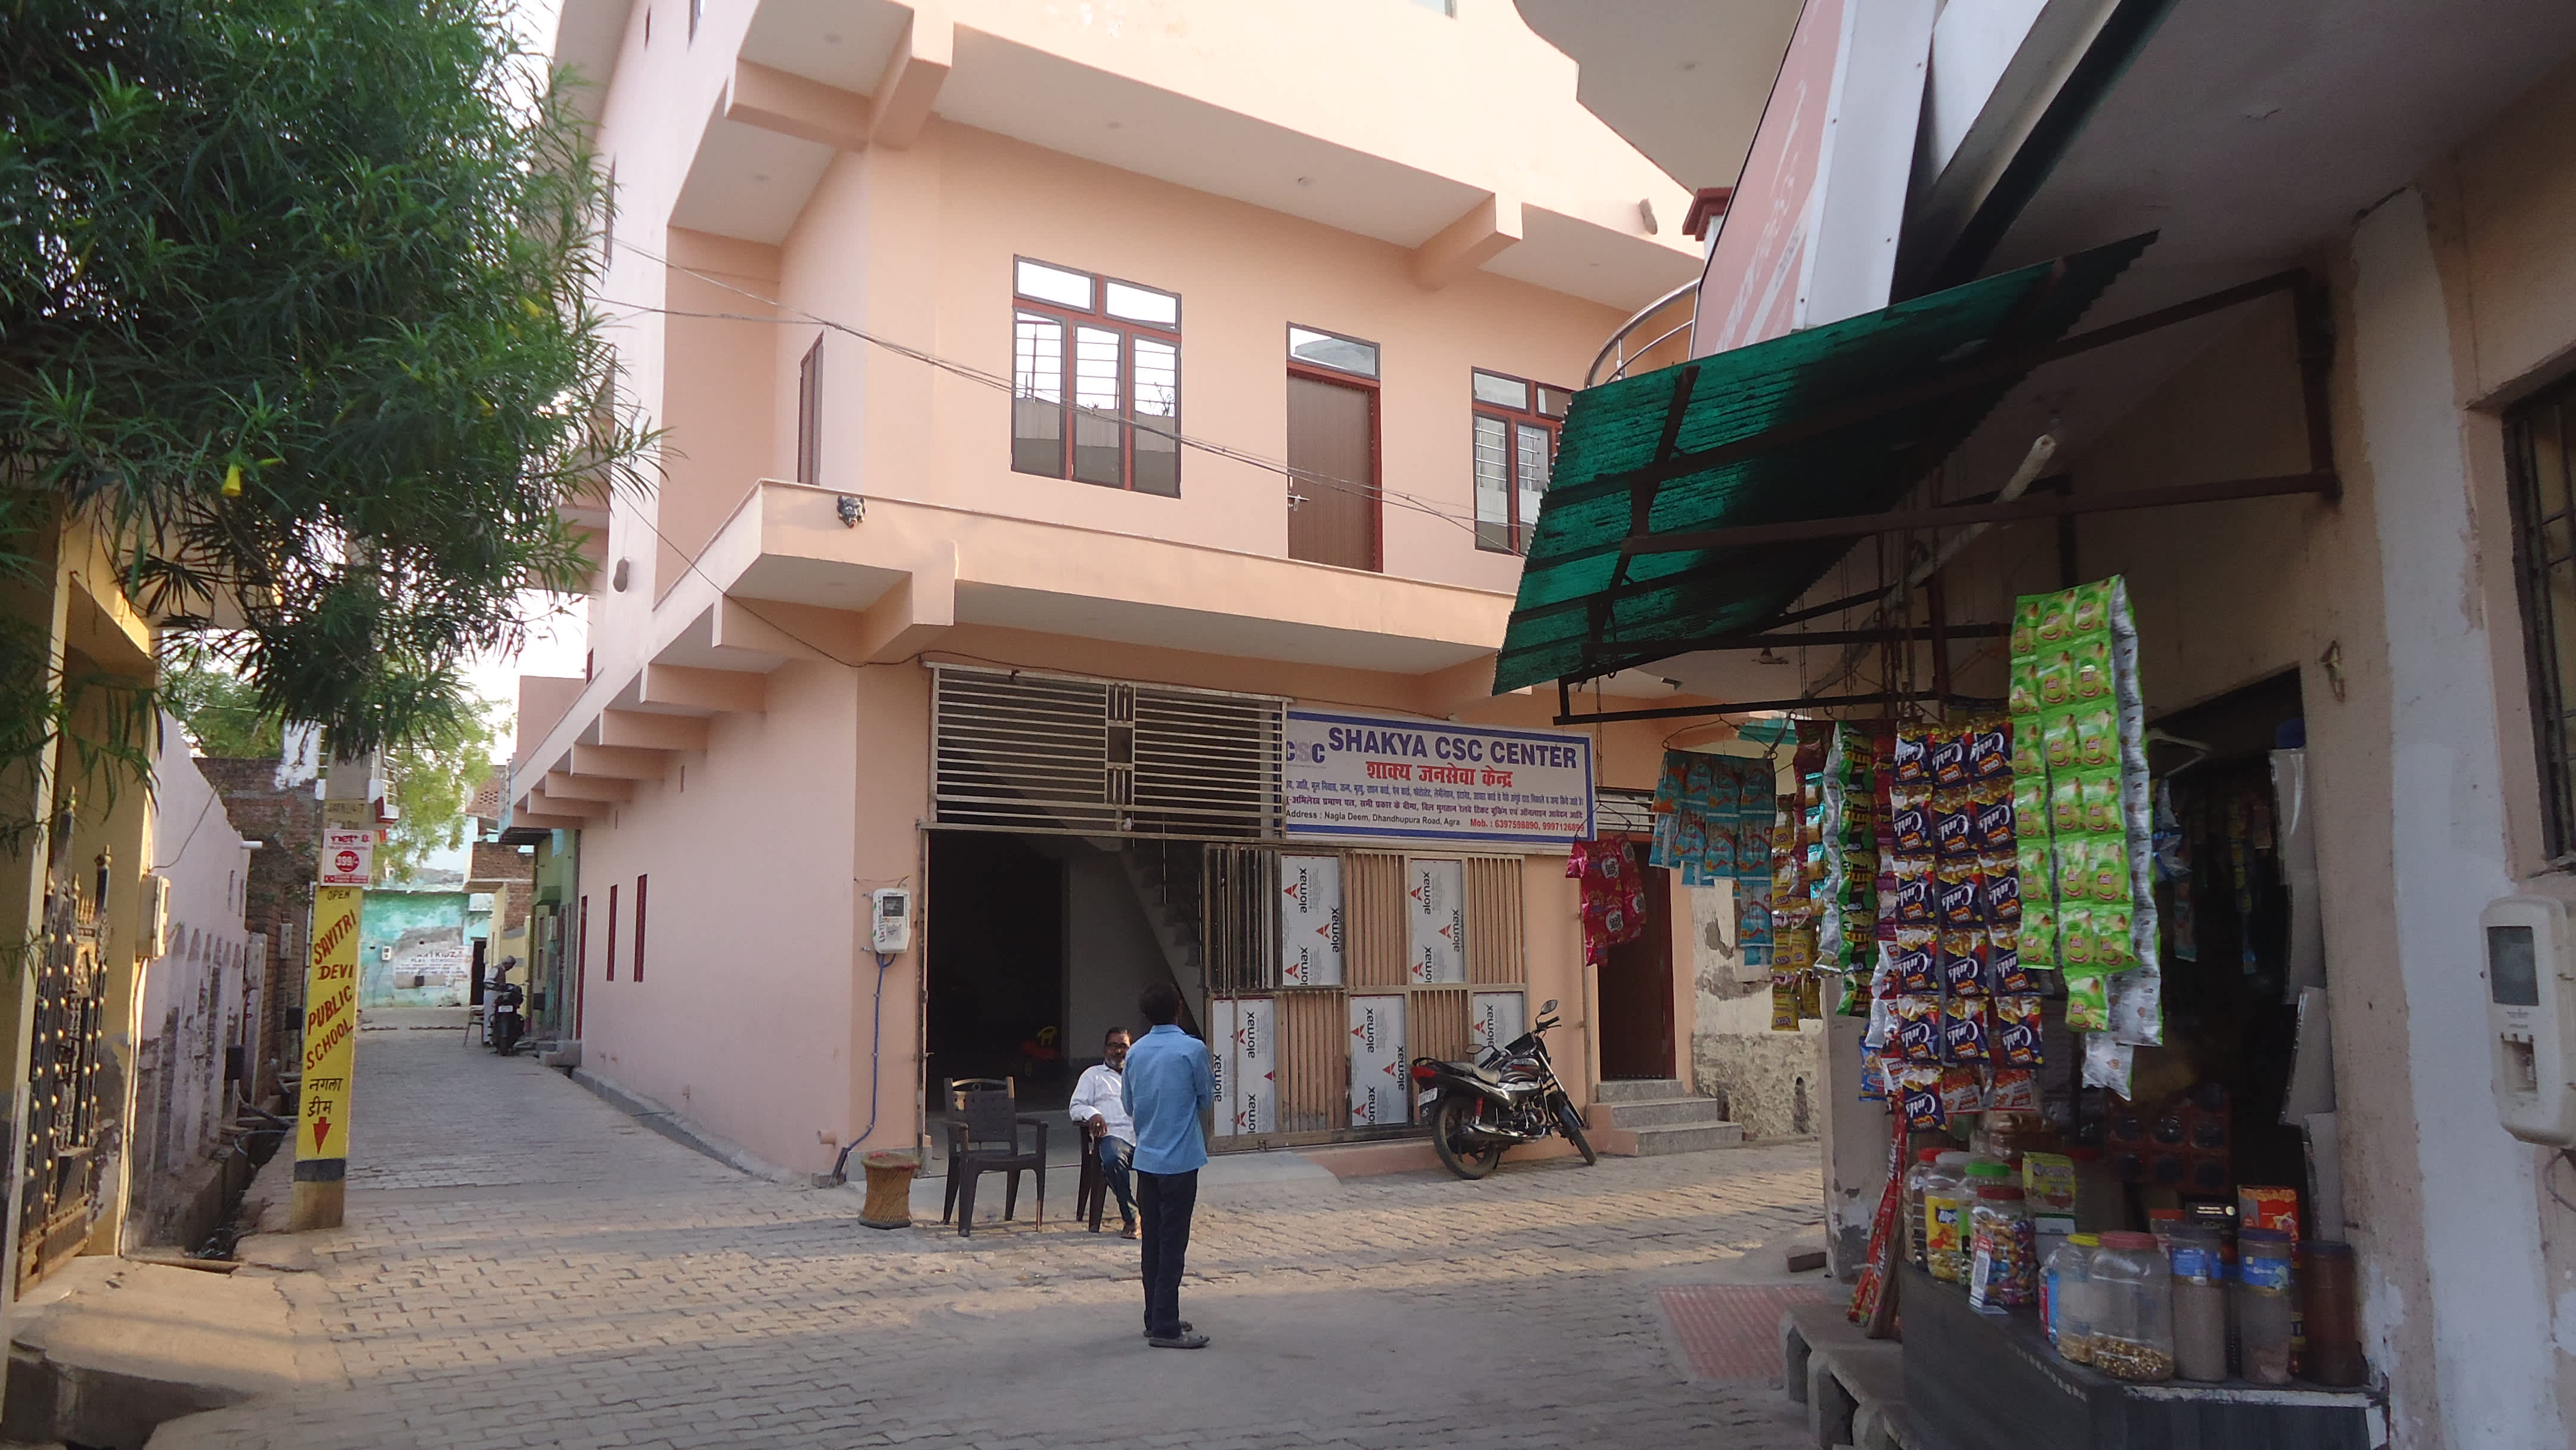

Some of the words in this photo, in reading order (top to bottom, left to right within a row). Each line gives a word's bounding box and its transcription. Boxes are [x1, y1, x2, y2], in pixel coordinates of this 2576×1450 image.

[1329, 727, 1428, 758] SHAKYA
[1435, 736, 1482, 762] CSC
[1490, 741, 1577, 769] CENTER
[1894, 742, 1925, 767] Curls
[1931, 743, 1963, 771] Curls
[1969, 732, 2004, 761] Curls
[1366, 761, 1412, 781] शाक्य
[1417, 763, 1476, 786] जनसेवा
[1481, 765, 1513, 788] केन्द्र
[1286, 810, 1317, 819] Address
[1324, 811, 1345, 822] Nagla
[1348, 813, 1371, 822] Deem,
[1373, 814, 1420, 825] Dhandhupura
[1422, 816, 1442, 826] Road,
[1444, 818, 1460, 828] Agra
[1470, 819, 1488, 828] Mob.
[1494, 820, 1540, 831] 6397598890,
[1323, 797, 1341, 805] प्रमाण
[1360, 798, 1373, 808] सभी
[1375, 800, 1391, 808] प्रकार
[1393, 800, 1400, 810] के
[1402, 801, 1419, 811] बीमा,
[1422, 802, 1434, 811] बिल
[1459, 804, 1472, 813] रेलवे
[1474, 804, 1488, 814] टिकट
[1509, 806, 1518, 816] एवं
[1549, 809, 1567, 819] आवेदन
[1569, 809, 1583, 819] आदि
[1979, 804, 2011, 833] Curls
[1894, 810, 1923, 836] Curls
[327, 890, 351, 901] OPEN
[1299, 867, 1308, 913] alomax
[1423, 870, 1431, 915] alomax
[1897, 881, 1925, 907] Curls
[1941, 885, 1974, 911] Curls
[1989, 876, 2019, 904] Curls
[314, 909, 357, 965] SAVITRI
[1331, 907, 1340, 953] alomax
[1451, 909, 1460, 953] alomax
[318, 963, 354, 981] DEVI
[1299, 946, 1308, 986] lomax
[1424, 946, 1432, 984] lomax
[1899, 952, 1928, 977] Curls
[1948, 958, 1979, 983] Curls
[307, 985, 354, 1036] PUBLIC
[1246, 1011, 1255, 1059] alomax
[1366, 1008, 1374, 1054] alomax
[1486, 1004, 1494, 1047] alomax
[1901, 1021, 1930, 1048] Curls
[1946, 1020, 1979, 1046] Curls
[2002, 1024, 2032, 1051] Curls
[306, 1021, 354, 1070] SCHOOL
[1213, 1054, 1222, 1102] alomax
[1397, 1045, 1405, 1091] alomax
[309, 1077, 343, 1092] नगला
[308, 1099, 333, 1117] डीम
[1247, 1093, 1256, 1133] lomax
[1367, 1086, 1376, 1125] lomax
[1906, 1093, 1936, 1118] Curls
